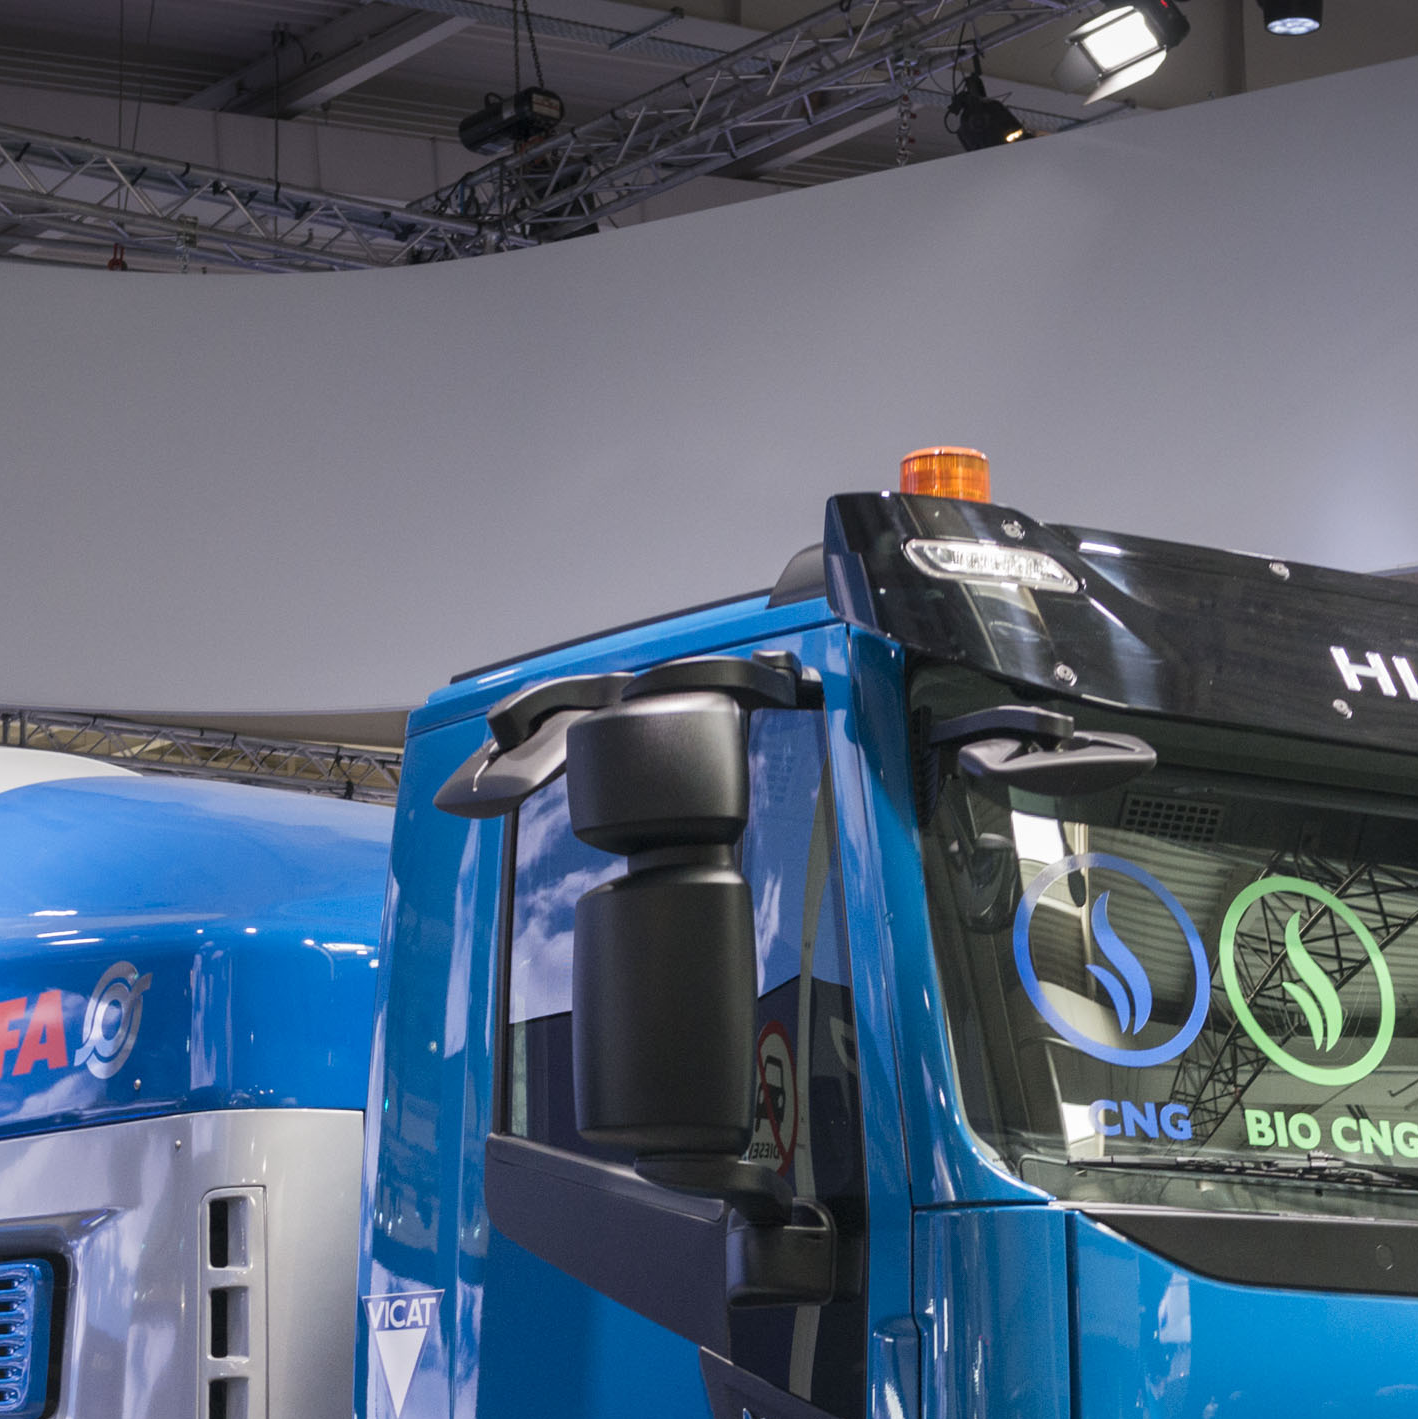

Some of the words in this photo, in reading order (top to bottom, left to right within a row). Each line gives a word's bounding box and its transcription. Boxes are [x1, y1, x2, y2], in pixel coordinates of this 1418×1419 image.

[1087, 1099, 1195, 1141] CNG
[1244, 1109, 1323, 1153] BIO
[368, 1297, 436, 1329] VICAT
